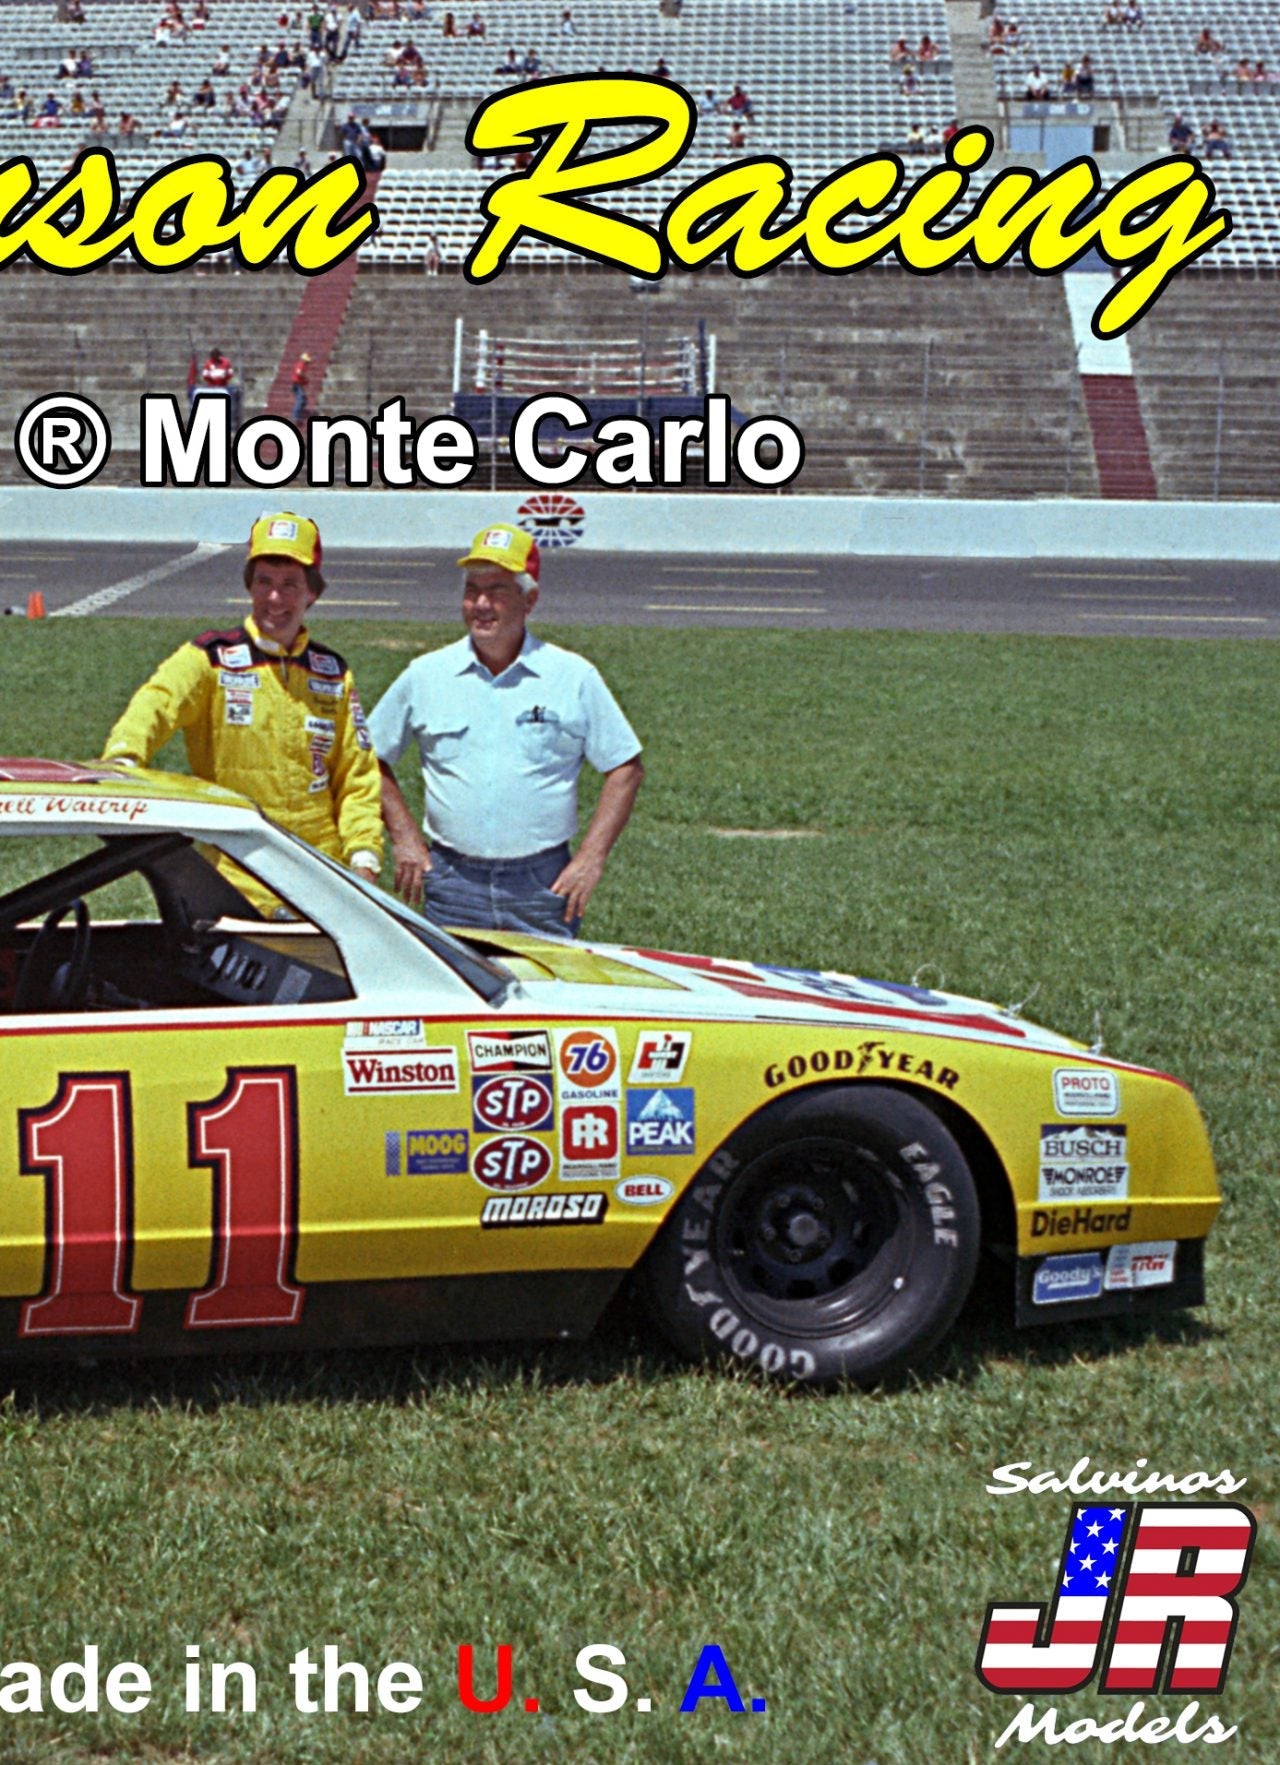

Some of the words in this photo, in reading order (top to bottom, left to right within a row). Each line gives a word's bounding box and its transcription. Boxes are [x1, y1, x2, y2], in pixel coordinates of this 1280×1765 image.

[474, 1043, 547, 1059] CHAMPION
[567, 1040, 609, 1074] 76
[346, 1058, 456, 1084] Winston
[1061, 1076, 1111, 1091] PROTO
[484, 1080, 542, 1120] STP
[561, 1089, 619, 1100] GASOLINE
[408, 1133, 467, 1157] MOOG
[628, 1121, 694, 1146] PEAK
[481, 1140, 543, 1181] STP
[1043, 1139, 1122, 1157] BUSCH
[1055, 1166, 1117, 1185] MONROE
[17, 1065, 305, 1337] 11
[623, 1183, 665, 1198] BELL
[900, 1142, 959, 1248] EAGLE
[482, 1194, 604, 1224] MOROSO
[1030, 1206, 1132, 1238] DieHard
[1038, 1264, 1102, 1284] Goody's
